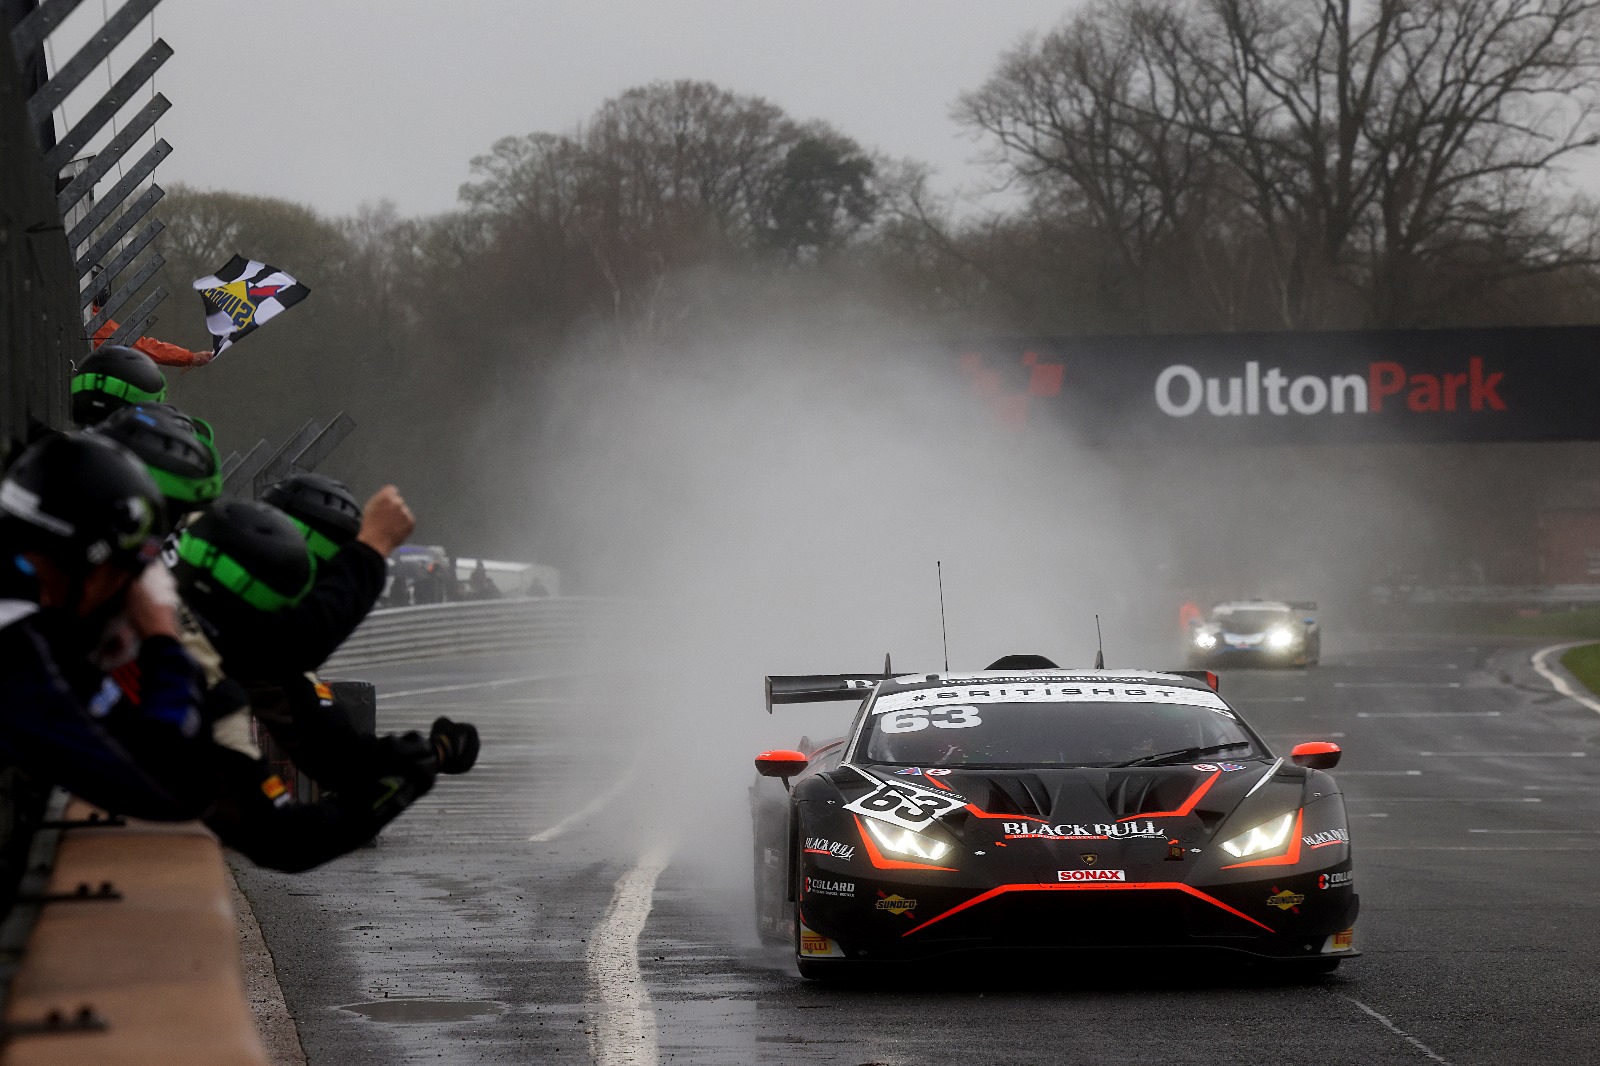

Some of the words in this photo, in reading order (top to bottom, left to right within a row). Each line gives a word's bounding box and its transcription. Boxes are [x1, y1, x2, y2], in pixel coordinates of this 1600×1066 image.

[912, 688, 1176, 702] #BRITISHGT
[880, 705, 983, 734] 63
[859, 785, 952, 822] 63
[1002, 822, 1093, 836] BLACK
[1093, 820, 1165, 838] BULL
[805, 837, 829, 850] BLACK
[829, 841, 855, 859] BULL
[1060, 870, 1121, 880] SONAX
[812, 880, 855, 892] COLLARD
[877, 900, 916, 909] SUNOCO
